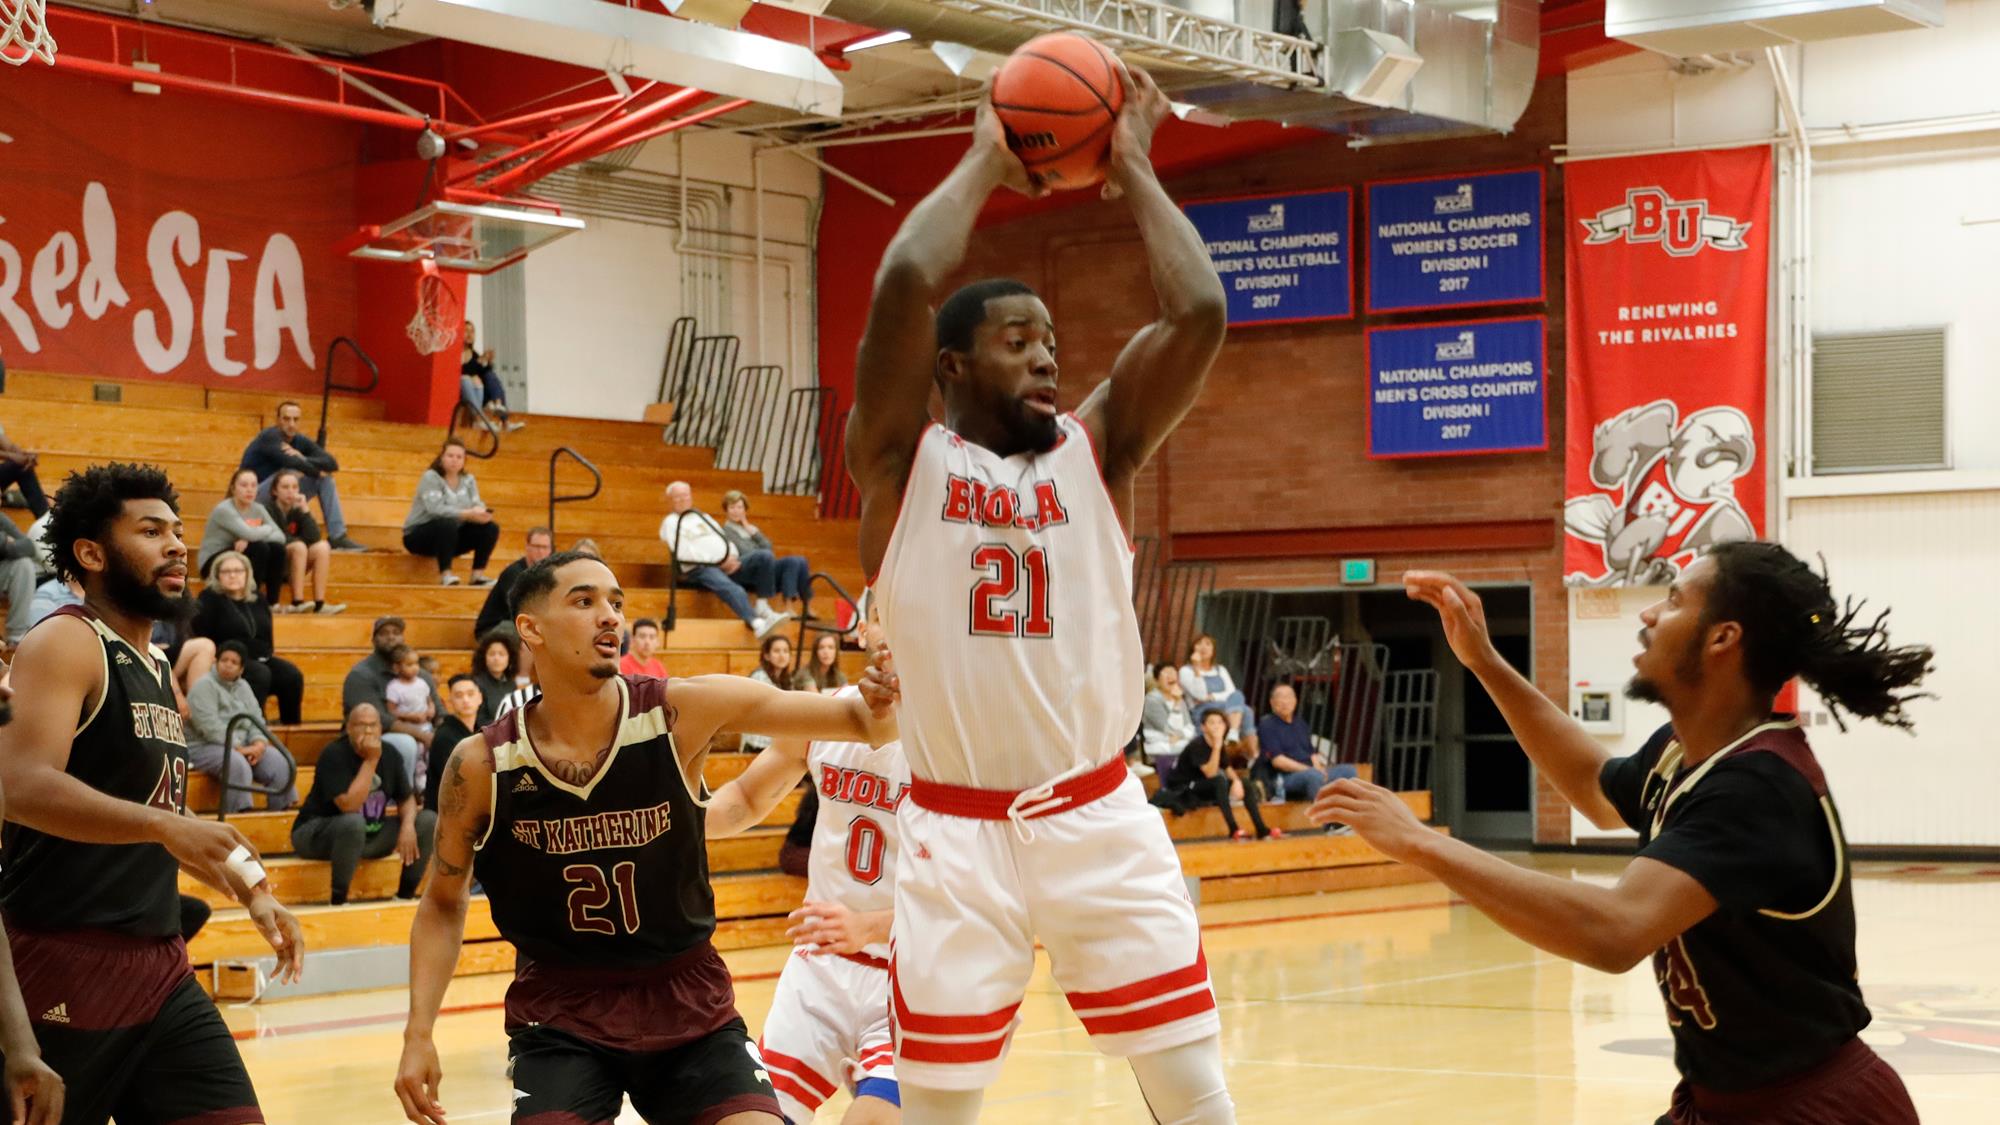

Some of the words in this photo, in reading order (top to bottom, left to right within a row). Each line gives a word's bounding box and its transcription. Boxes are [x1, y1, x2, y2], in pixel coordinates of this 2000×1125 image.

[1379, 221, 1445, 238] NATIONAL
[1448, 213, 1531, 232] CHAMPIONS
[1628, 188, 1706, 255] BU
[1206, 240, 1258, 254] ATIONAL
[1261, 232, 1339, 251] CHAMPIONS
[1392, 239, 1457, 255] WOMEN'S
[1459, 233, 1518, 251] SOCCER
[1213, 258, 1254, 273] MEN'S
[1256, 251, 1340, 270] VOLLEYBALL
[1421, 256, 1480, 273] DIVISION
[133, 210, 315, 376] SEA
[1235, 275, 1291, 290] DIVISION
[1439, 277, 1470, 292] 2017
[1252, 294, 1280, 308] 2017
[1618, 301, 1718, 320] RENEWING
[1598, 330, 1635, 345] THE
[1641, 323, 1737, 343] RIVALRIES
[1380, 368, 1446, 383] NATIONAL
[1450, 362, 1533, 379] CHAMPIONS
[1375, 388, 1418, 403] MEN'S
[1420, 385, 1468, 400] CROSS
[1471, 381, 1537, 397] COUNTRY
[1423, 404, 1482, 420] DIVISION
[1441, 425, 1471, 439] 2017
[942, 473, 1068, 533] BIOLA
[969, 543, 1053, 638] 21
[131, 702, 152, 738] ST
[511, 820, 541, 849] ST
[543, 801, 671, 855] KATHERINE
[846, 814, 886, 885] 0
[563, 861, 640, 935] 21
[42, 1013, 70, 1023] adidas
